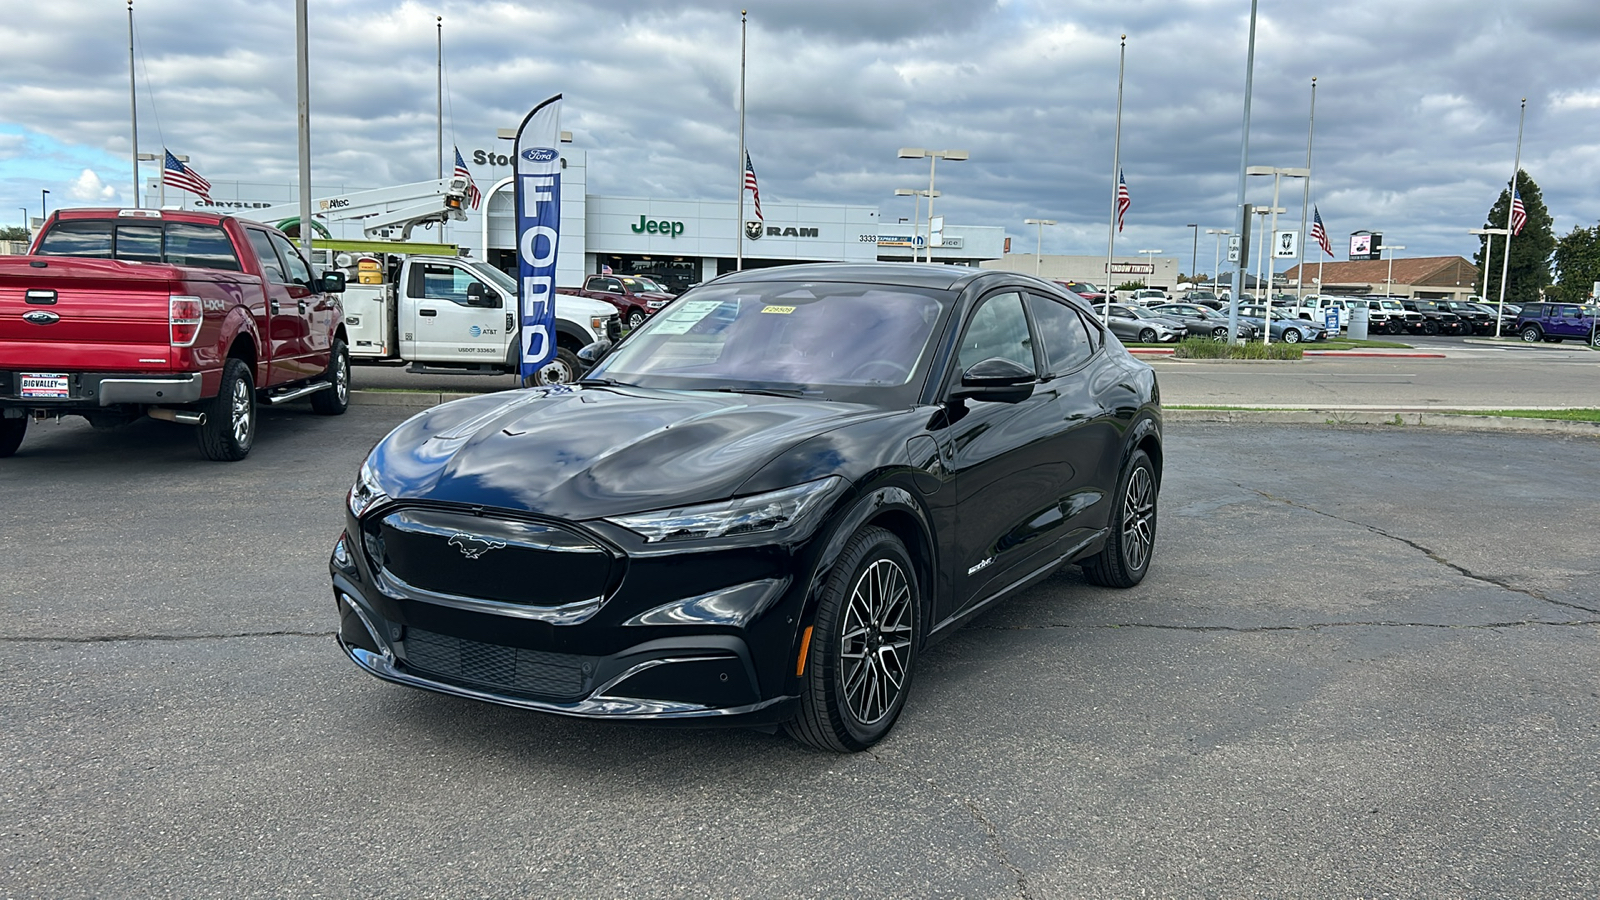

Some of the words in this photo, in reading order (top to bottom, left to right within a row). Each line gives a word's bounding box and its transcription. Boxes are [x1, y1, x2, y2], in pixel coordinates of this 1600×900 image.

[473, 149, 566, 169] Ston
[528, 149, 553, 160] Ford
[329, 199, 349, 208] Altec
[631, 215, 684, 238] Jeep
[767, 226, 818, 237] RAM
[859, 234, 876, 243] 3333
[521, 176, 557, 364] FORD
[1111, 264, 1130, 273] INDOW
